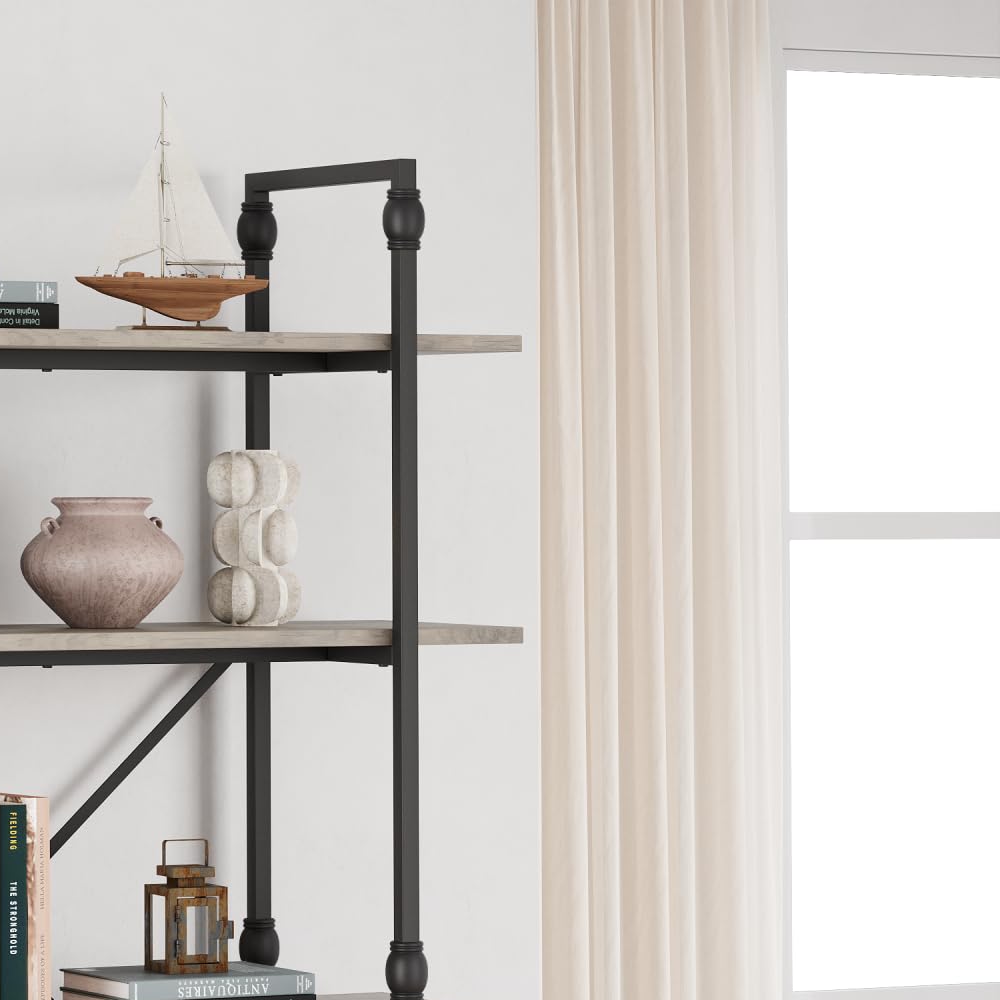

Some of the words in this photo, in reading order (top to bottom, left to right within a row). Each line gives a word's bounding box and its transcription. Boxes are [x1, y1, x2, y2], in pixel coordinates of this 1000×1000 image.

[16, 307, 40, 316] Virginia
[22, 318, 40, 326] Detail
[178, 983, 270, 998] ANTIQUAIRES
